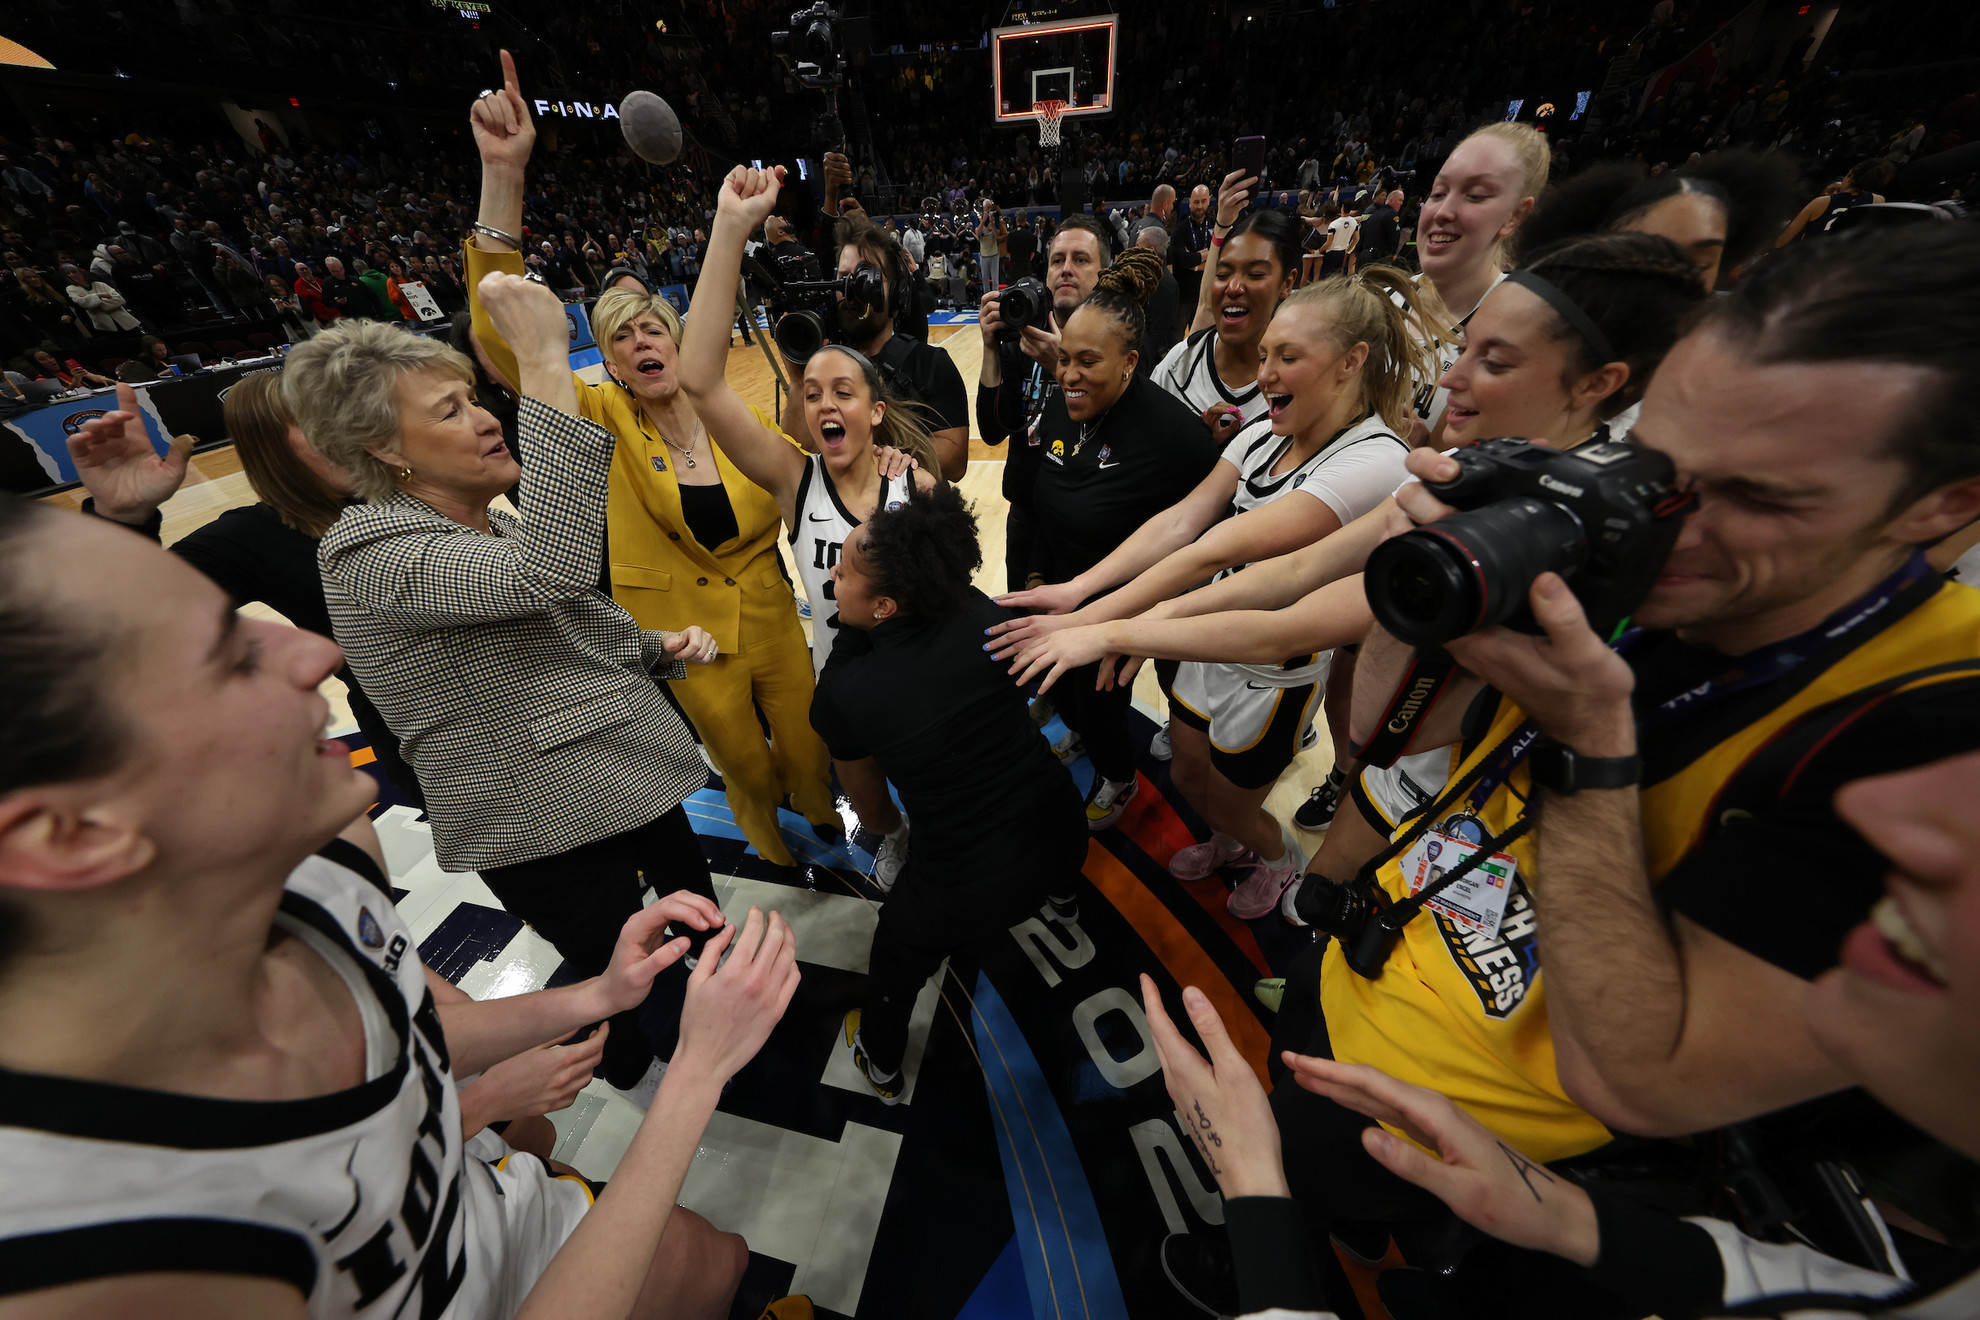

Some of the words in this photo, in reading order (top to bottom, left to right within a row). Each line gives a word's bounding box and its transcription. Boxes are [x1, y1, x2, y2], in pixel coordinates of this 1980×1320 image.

[1538, 474, 1585, 498] Canon
[1387, 677, 1436, 734] Canon
[1511, 730, 1539, 758] ALL
[1459, 876, 1480, 889] ORGAN
